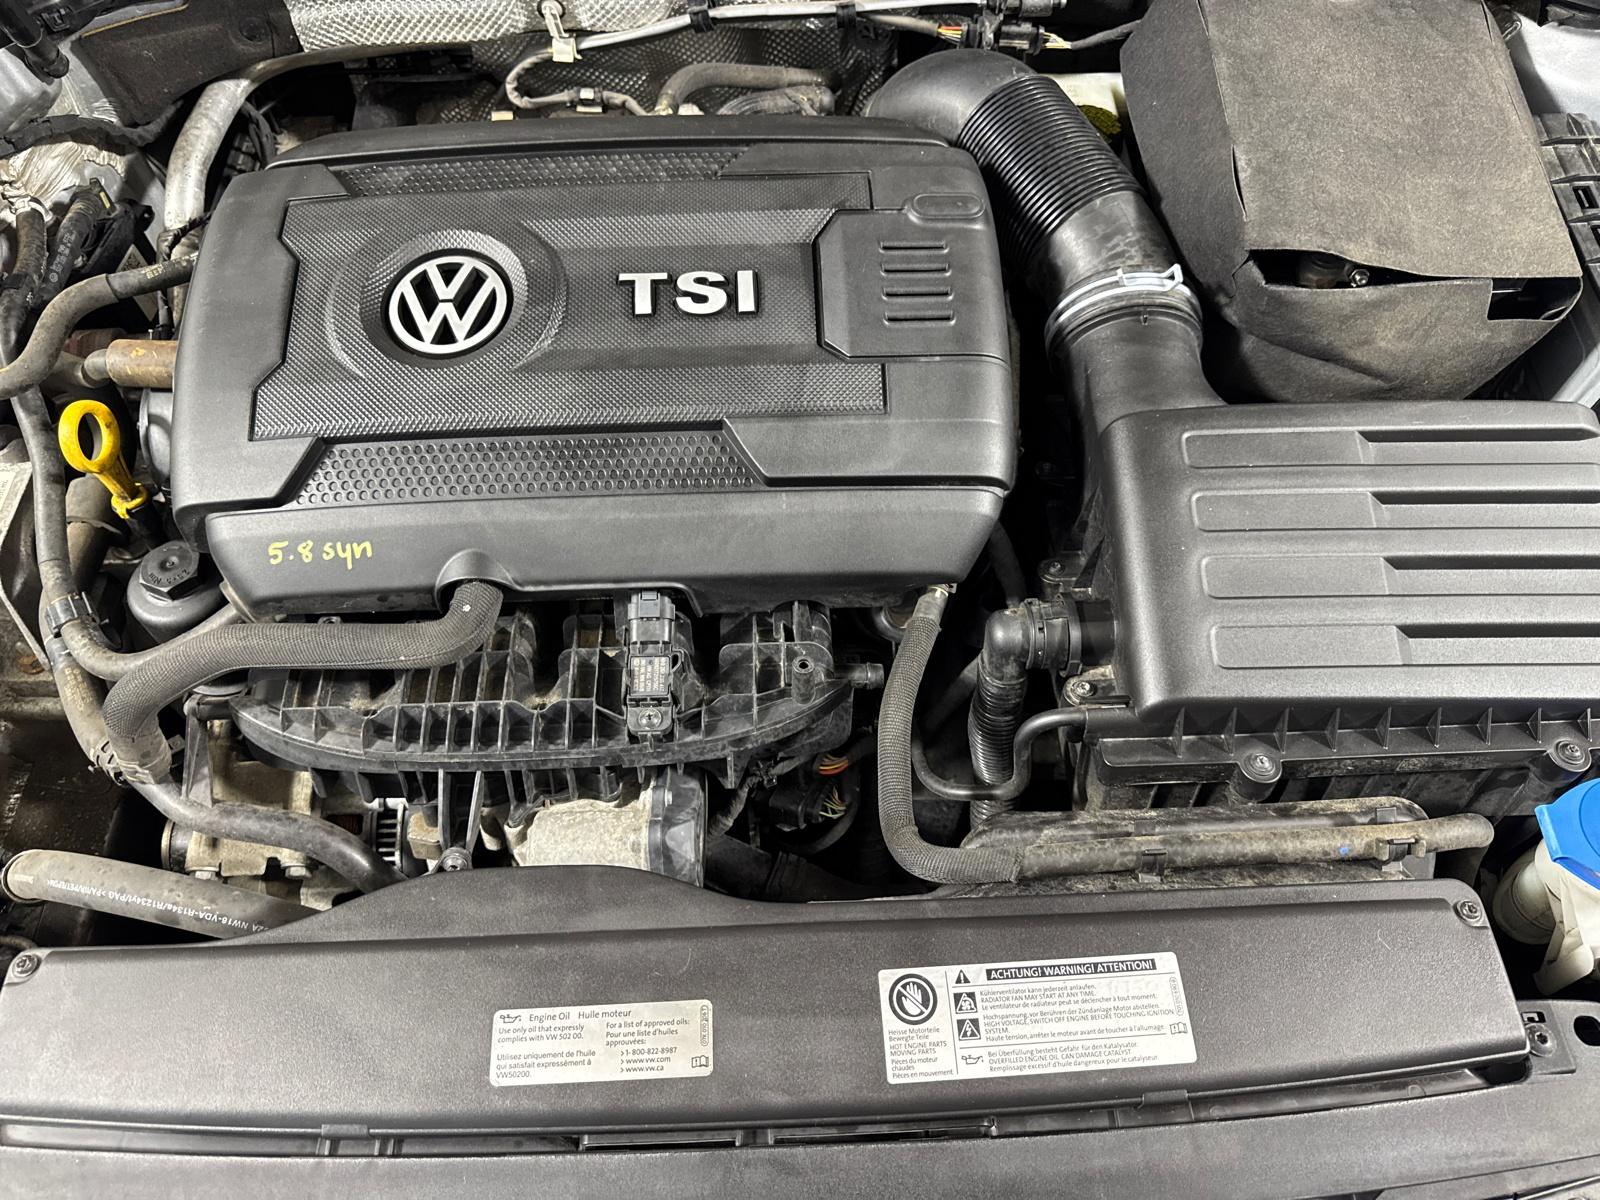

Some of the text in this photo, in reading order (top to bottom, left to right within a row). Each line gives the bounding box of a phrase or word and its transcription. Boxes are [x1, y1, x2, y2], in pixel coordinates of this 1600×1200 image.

[618, 270, 756, 315] TSI
[389, 256, 507, 354] VW
[268, 540, 373, 570] 5.8 syn
[990, 960, 1153, 979] ACHTUNG! WARNING! ATTENTION!
[981, 995, 1010, 1003] RADIATOR
[1039, 992, 1056, 1000] START
[989, 1002, 1021, 1010] ventilateur
[529, 1009, 632, 1023] Engine Oil Huile moteur
[1030, 1017, 1053, 1025] SWITCH
[1066, 1014, 1089, 1022] ENGINE
[1090, 1012, 1112, 1020] BEFORE
[1113, 1011, 1145, 1019] TOUCHING
[1146, 1008, 1174, 1017] IGNITION
[606, 1021, 617, 1029] For
[623, 1020, 634, 1028] list
[635, 1019, 643, 1027] of
[643, 1018, 675, 1029] approved
[498, 1027, 511, 1035] Use
[512, 1026, 527, 1036] only
[528, 1025, 537, 1033] oil
[553, 1023, 585, 1033] expressly
[605, 1031, 621, 1039] Pour
[636, 1029, 651, 1037] liste
[652, 1028, 678, 1036] d'huiles
[985, 1034, 1004, 1042] Haute
[1079, 1028, 1097, 1036] avant
[497, 1035, 528, 1044] complies
[545, 1033, 558, 1041] VW
[572, 1032, 584, 1040] 00.
[605, 1038, 647, 1048] approuvées:
[497, 1049, 596, 1061] Utilisez uniquement de l'huile
[625, 1046, 678, 1056] 1-800-822-8987
[890, 1047, 937, 1057] MOVING PARTS
[988, 1050, 998, 1058] Bei
[1035, 1047, 1058, 1055] besteht
[625, 1056, 671, 1064] www.vw.com
[988, 1057, 1024, 1065] OVERFILLED
[1024, 1055, 1048, 1063] ENGINE
[1075, 1050, 1102, 1059] DAMAGE
[496, 1058, 592, 1071] qui satisfait expressément à
[625, 1065, 664, 1073] www.vw.ca
[891, 1064, 915, 1072] chaudes
[989, 1063, 1027, 1072] Remplissage
[1027, 1061, 1051, 1069] excessif
[918, 1068, 954, 1077] mouvement
